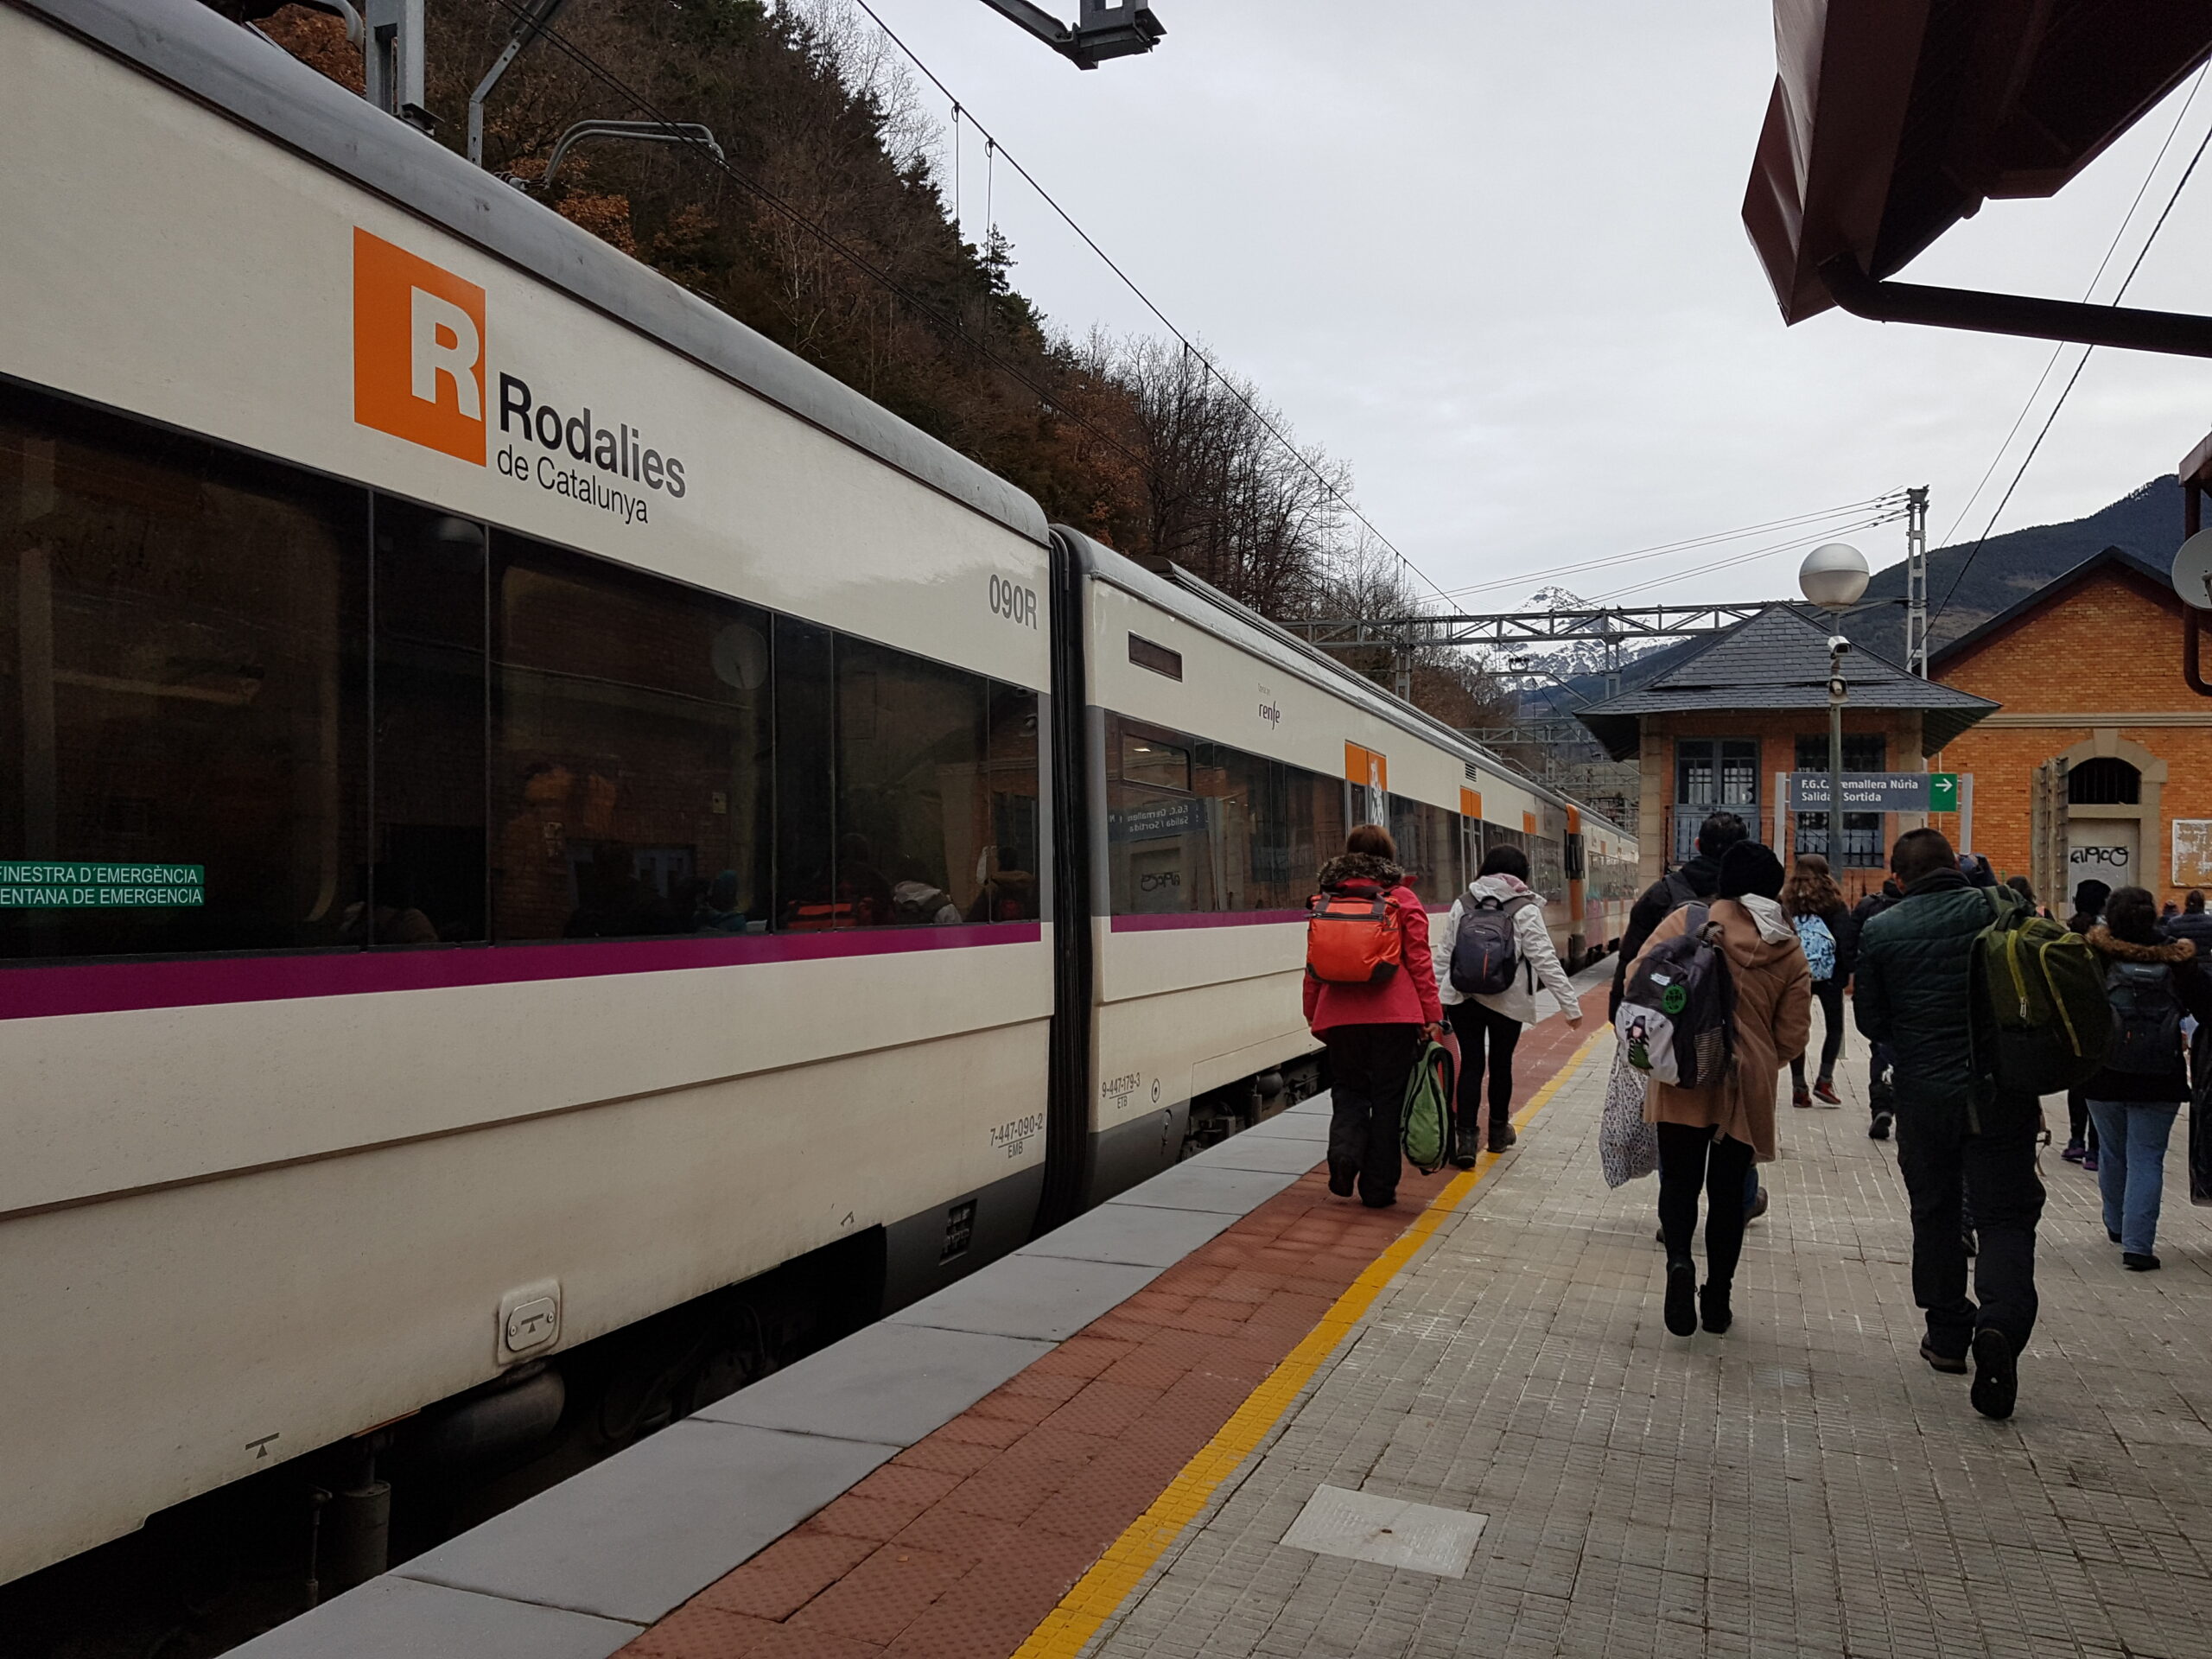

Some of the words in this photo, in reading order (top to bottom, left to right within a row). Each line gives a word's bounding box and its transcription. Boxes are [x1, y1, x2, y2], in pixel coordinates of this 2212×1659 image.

[411, 285, 481, 422] R
[499, 372, 685, 498] Rodalies
[497, 444, 529, 480] de
[537, 456, 648, 524] Catalunya
[989, 575, 1037, 630] 090R
[1259, 701, 1280, 730] renfe
[1843, 791, 1882, 802] Sortida
[1890, 779, 1918, 789] Núria
[0, 888, 69, 904] ENTANA
[73, 888, 95, 904] DE
[99, 888, 203, 904] EMERGENCIA
[1007, 1141, 1024, 1159] EMB
